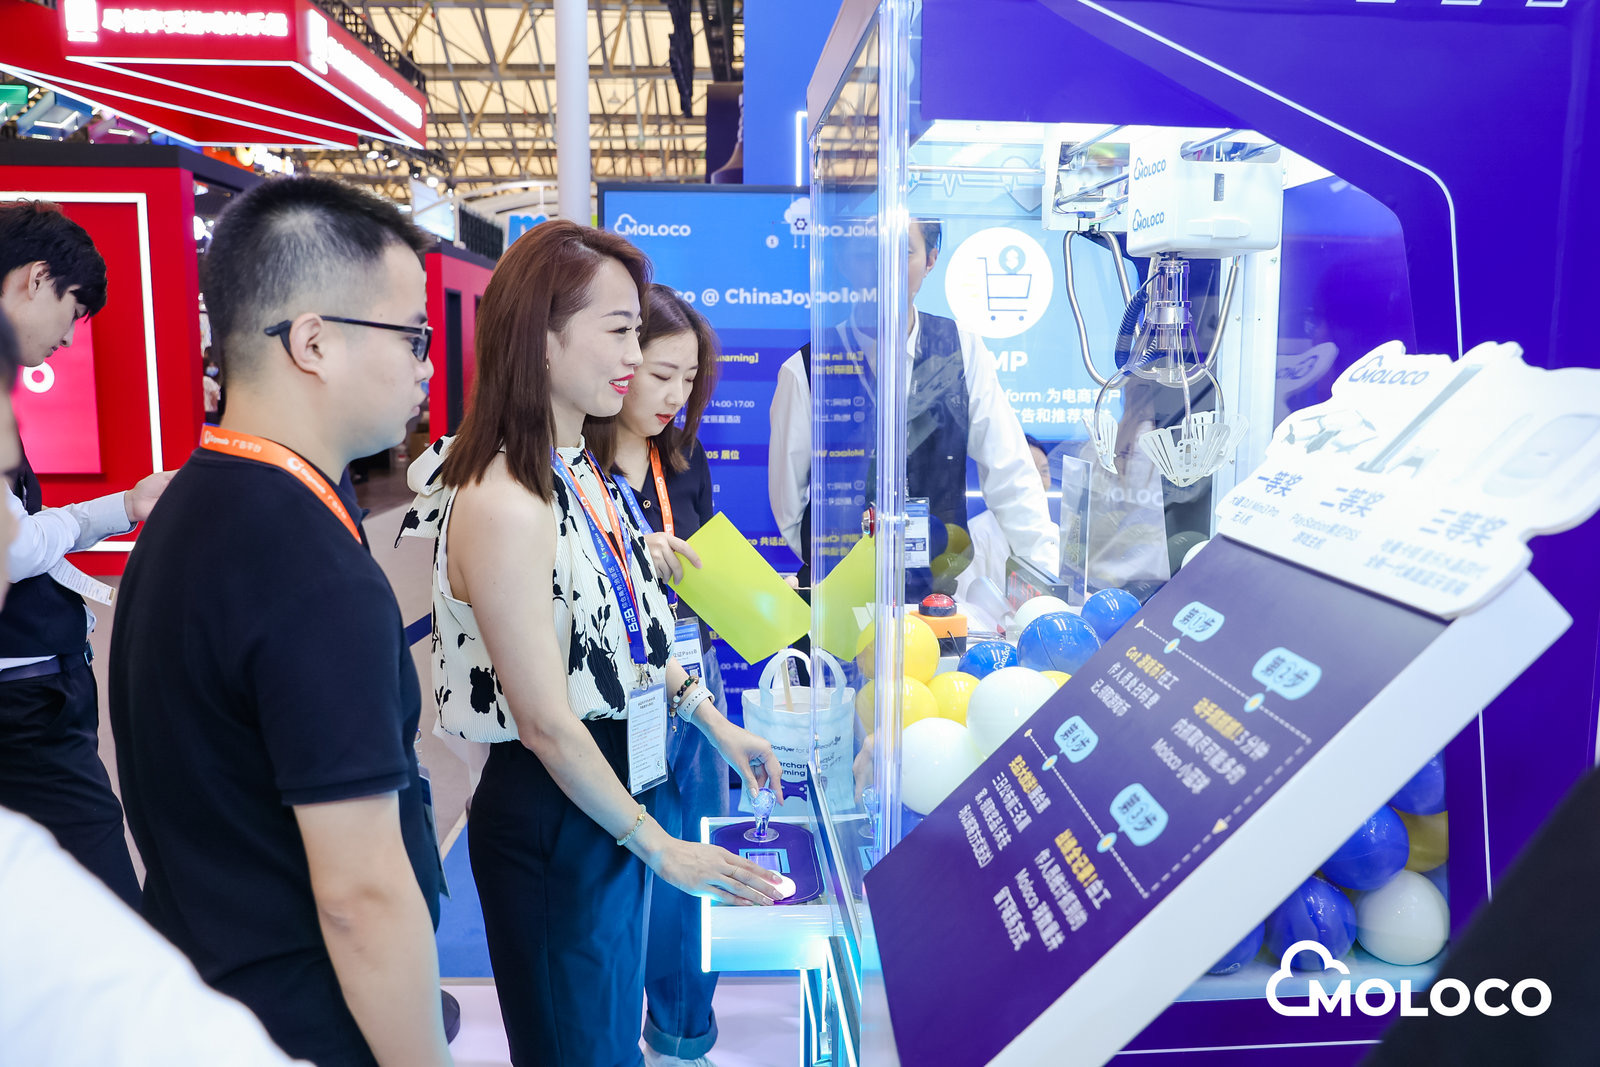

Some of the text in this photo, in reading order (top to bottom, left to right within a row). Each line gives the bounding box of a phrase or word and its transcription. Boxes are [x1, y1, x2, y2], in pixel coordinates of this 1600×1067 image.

[1138, 159, 1166, 178] MOLOCO
[625, 224, 691, 236] MOLOCO
[1136, 211, 1165, 230] MOLOCO
[725, 287, 811, 308] ChinaJoy
[1359, 369, 1430, 386] MOLOCO
[1257, 470, 1303, 497] 一等奖
[1319, 485, 1386, 518] 二等奖
[1419, 508, 1508, 548] 三等奖
[1152, 737, 1182, 771] Moloco
[1015, 867, 1040, 909] Moloco
